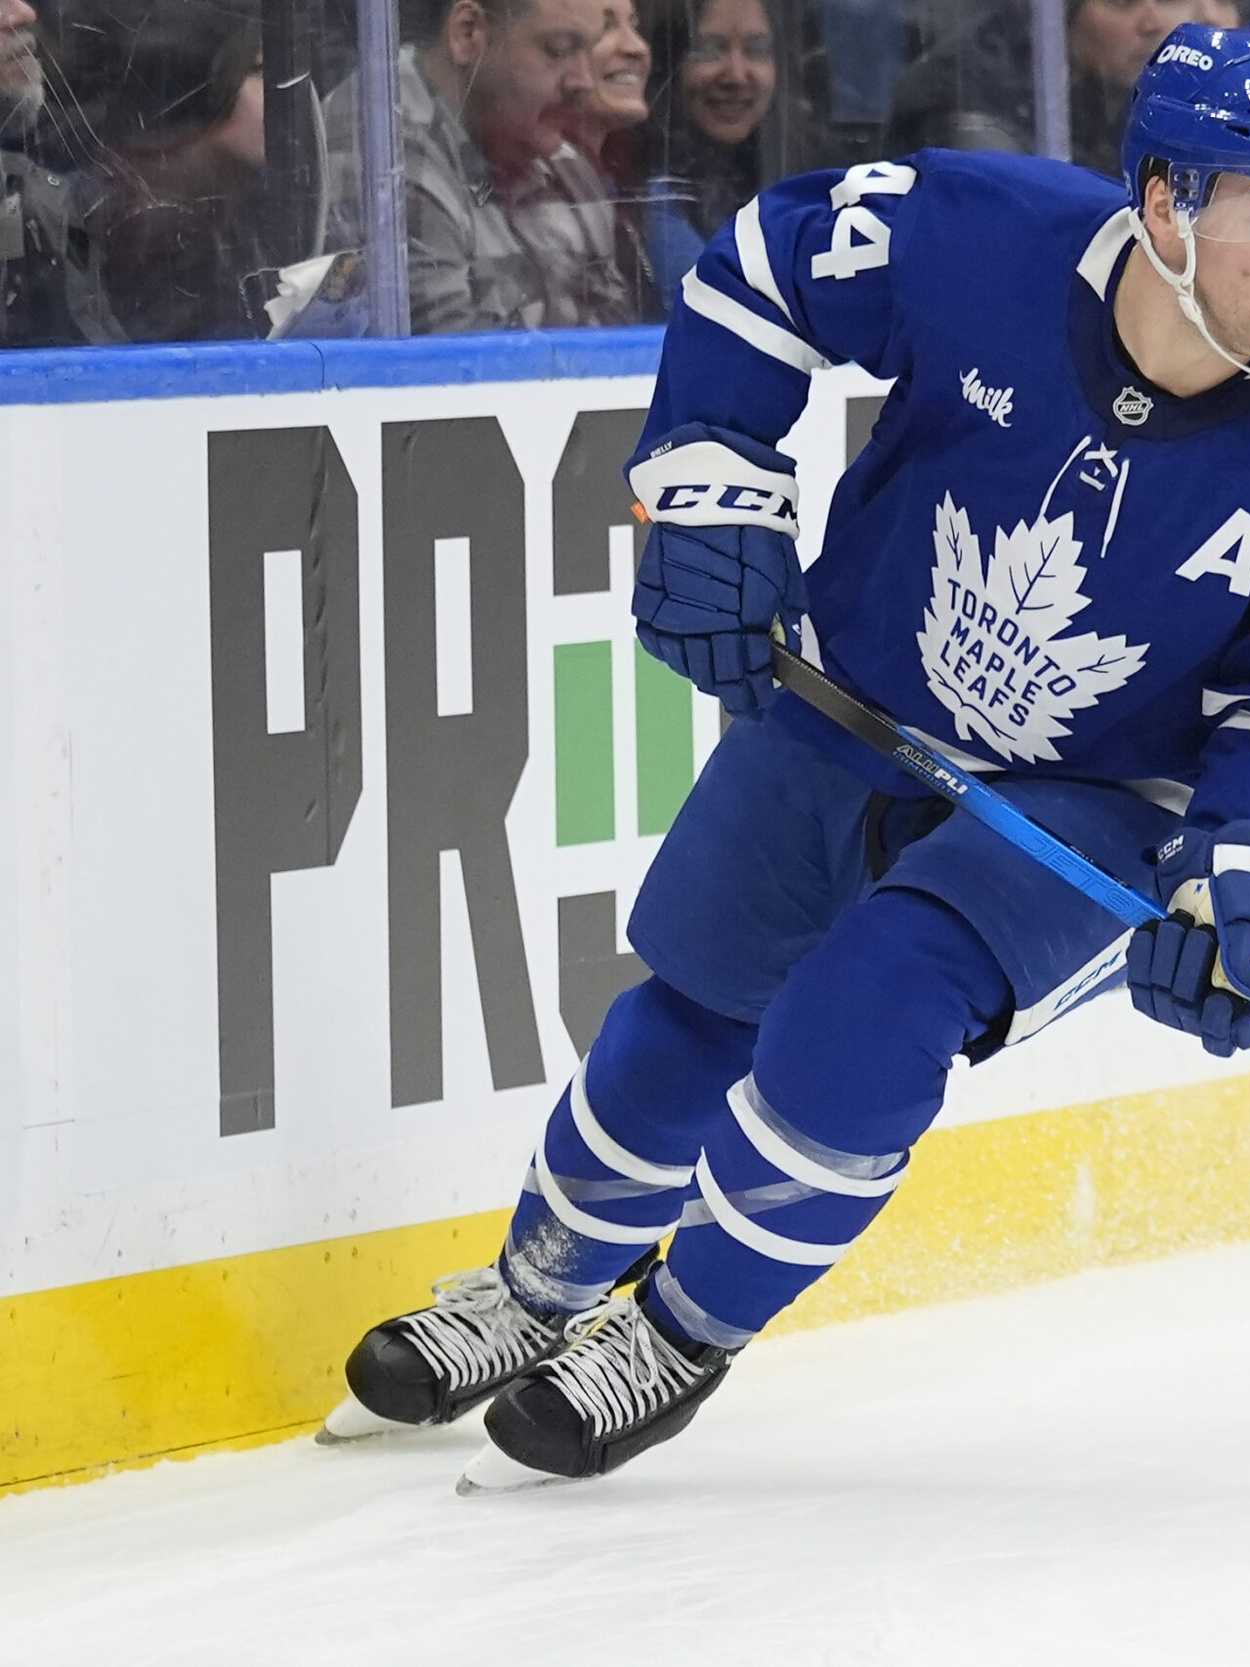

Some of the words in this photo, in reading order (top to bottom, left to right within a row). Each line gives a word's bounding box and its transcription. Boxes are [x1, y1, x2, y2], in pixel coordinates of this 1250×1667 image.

[1156, 44, 1214, 71] OREO
[812, 161, 917, 280] 44
[959, 367, 1014, 428] Milk
[1119, 402, 1144, 412] NHL
[948, 579, 1077, 697] TORONTO
[950, 616, 1043, 704] MAPLE
[941, 647, 1030, 728] LEAFS
[1158, 835, 1184, 860] CCM
[1053, 949, 1123, 1012] CCM
